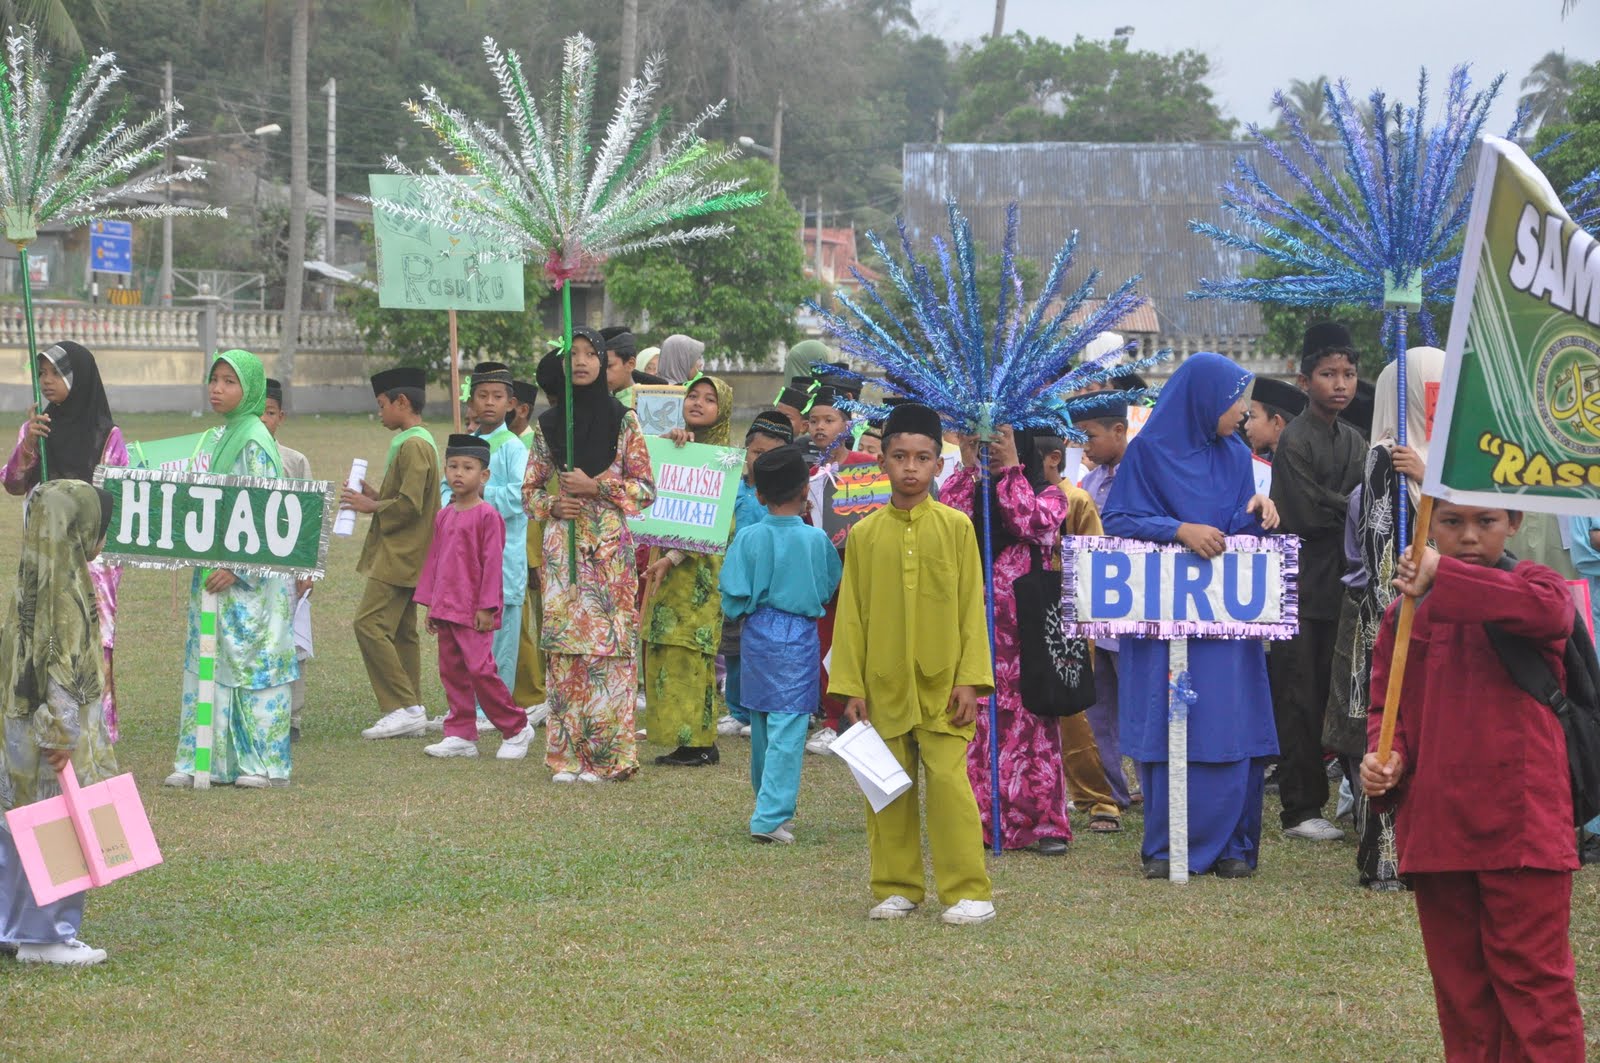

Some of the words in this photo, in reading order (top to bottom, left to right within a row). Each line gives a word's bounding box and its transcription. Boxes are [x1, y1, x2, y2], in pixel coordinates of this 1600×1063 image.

[657, 464, 722, 497] MALAYSIA
[116, 479, 303, 558] HIJAU
[652, 498, 716, 525] UMMAH
[1091, 550, 1268, 622] BIRU
